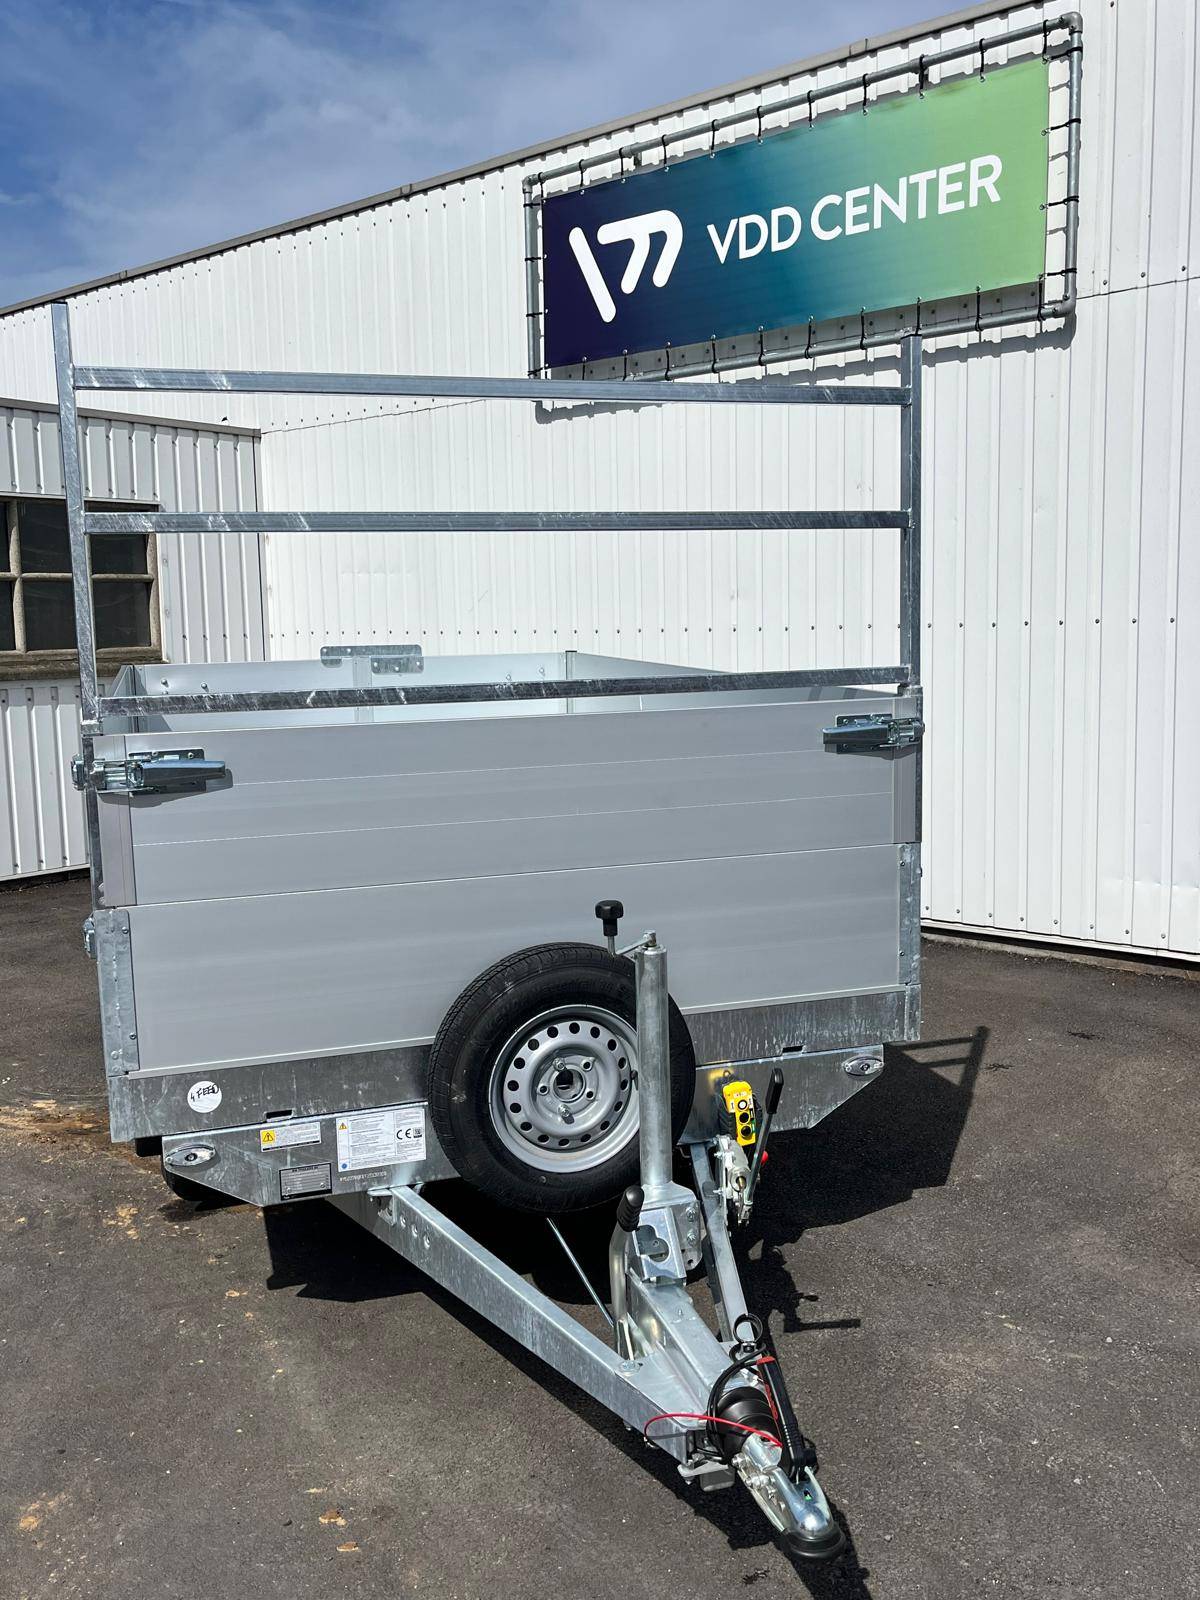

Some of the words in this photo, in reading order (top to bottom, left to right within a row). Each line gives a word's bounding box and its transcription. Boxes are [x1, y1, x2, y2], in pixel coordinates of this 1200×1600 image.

[707, 206, 801, 264] VDD
[810, 154, 1002, 241] CENTER
[396, 1128, 412, 1140] CE
